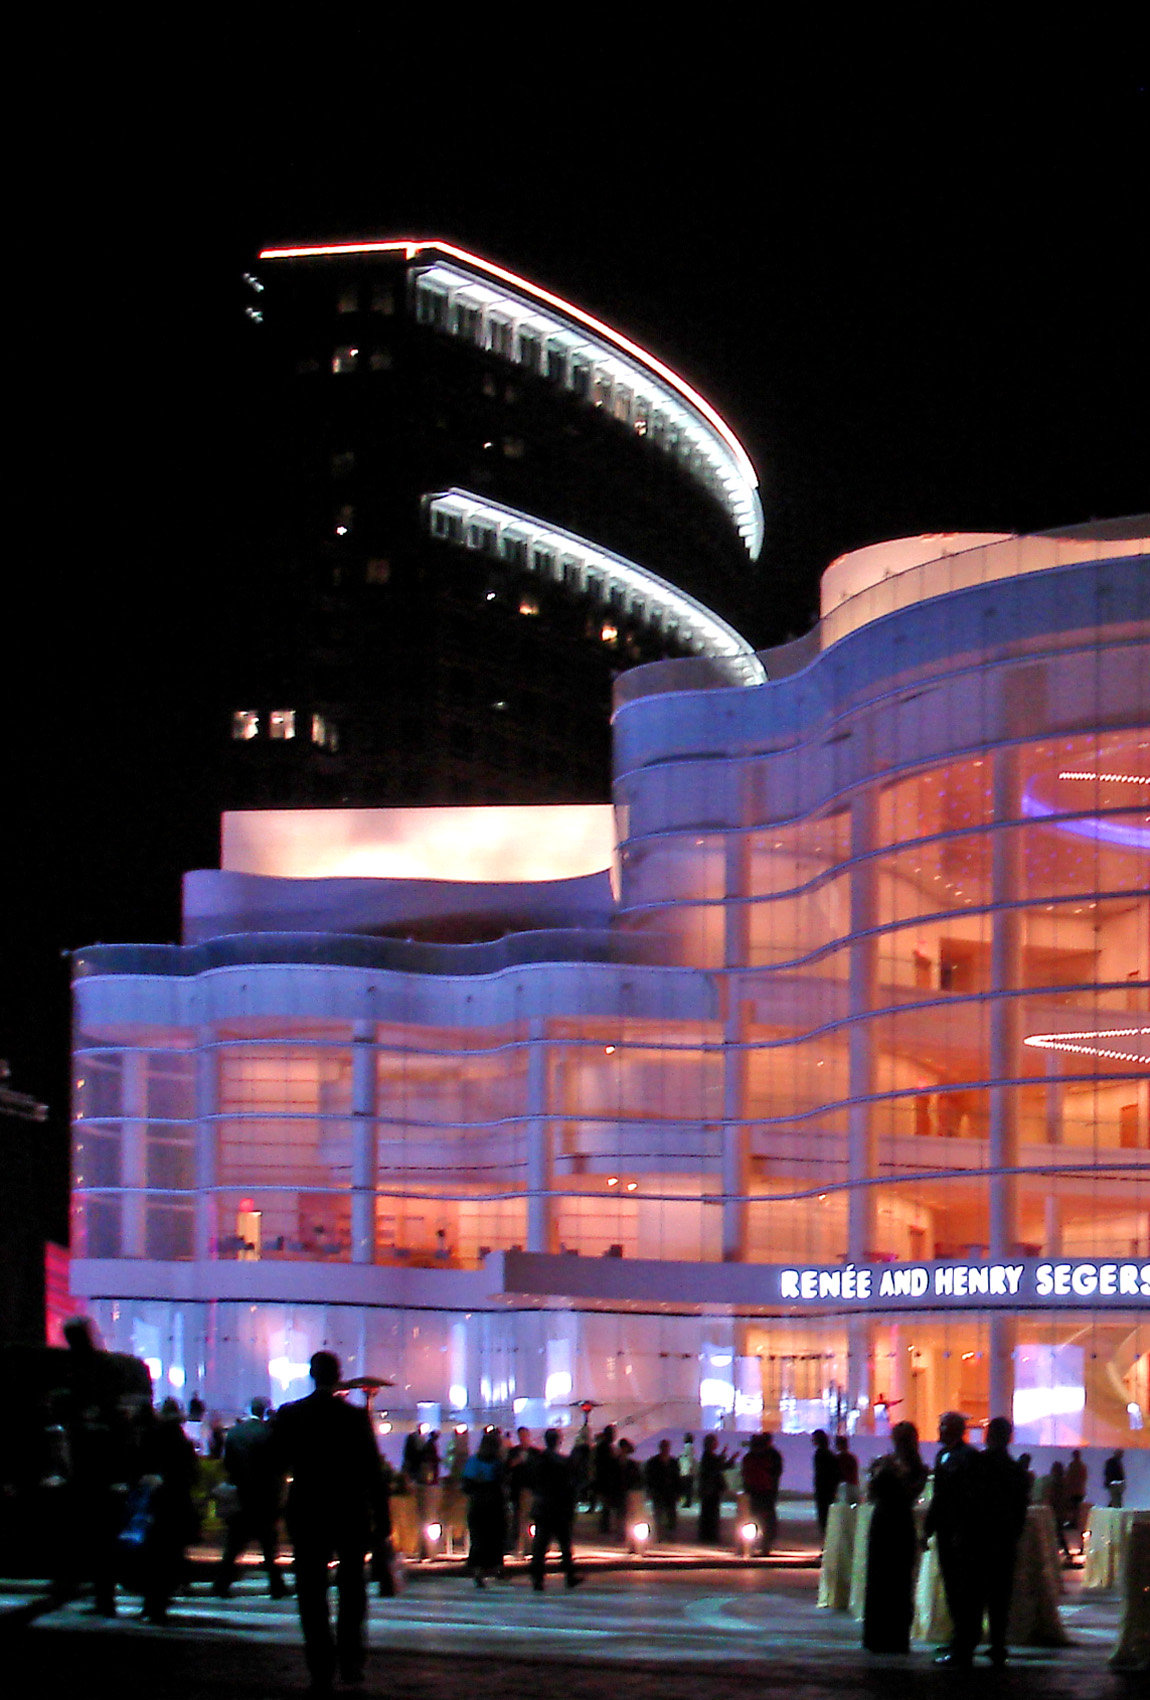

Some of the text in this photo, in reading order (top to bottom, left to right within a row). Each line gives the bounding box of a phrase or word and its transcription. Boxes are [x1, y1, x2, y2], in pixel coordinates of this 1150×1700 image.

[781, 1264, 871, 1299] RENÉE
[879, 1268, 928, 1297] AND
[934, 1265, 1024, 1296] HENRY
